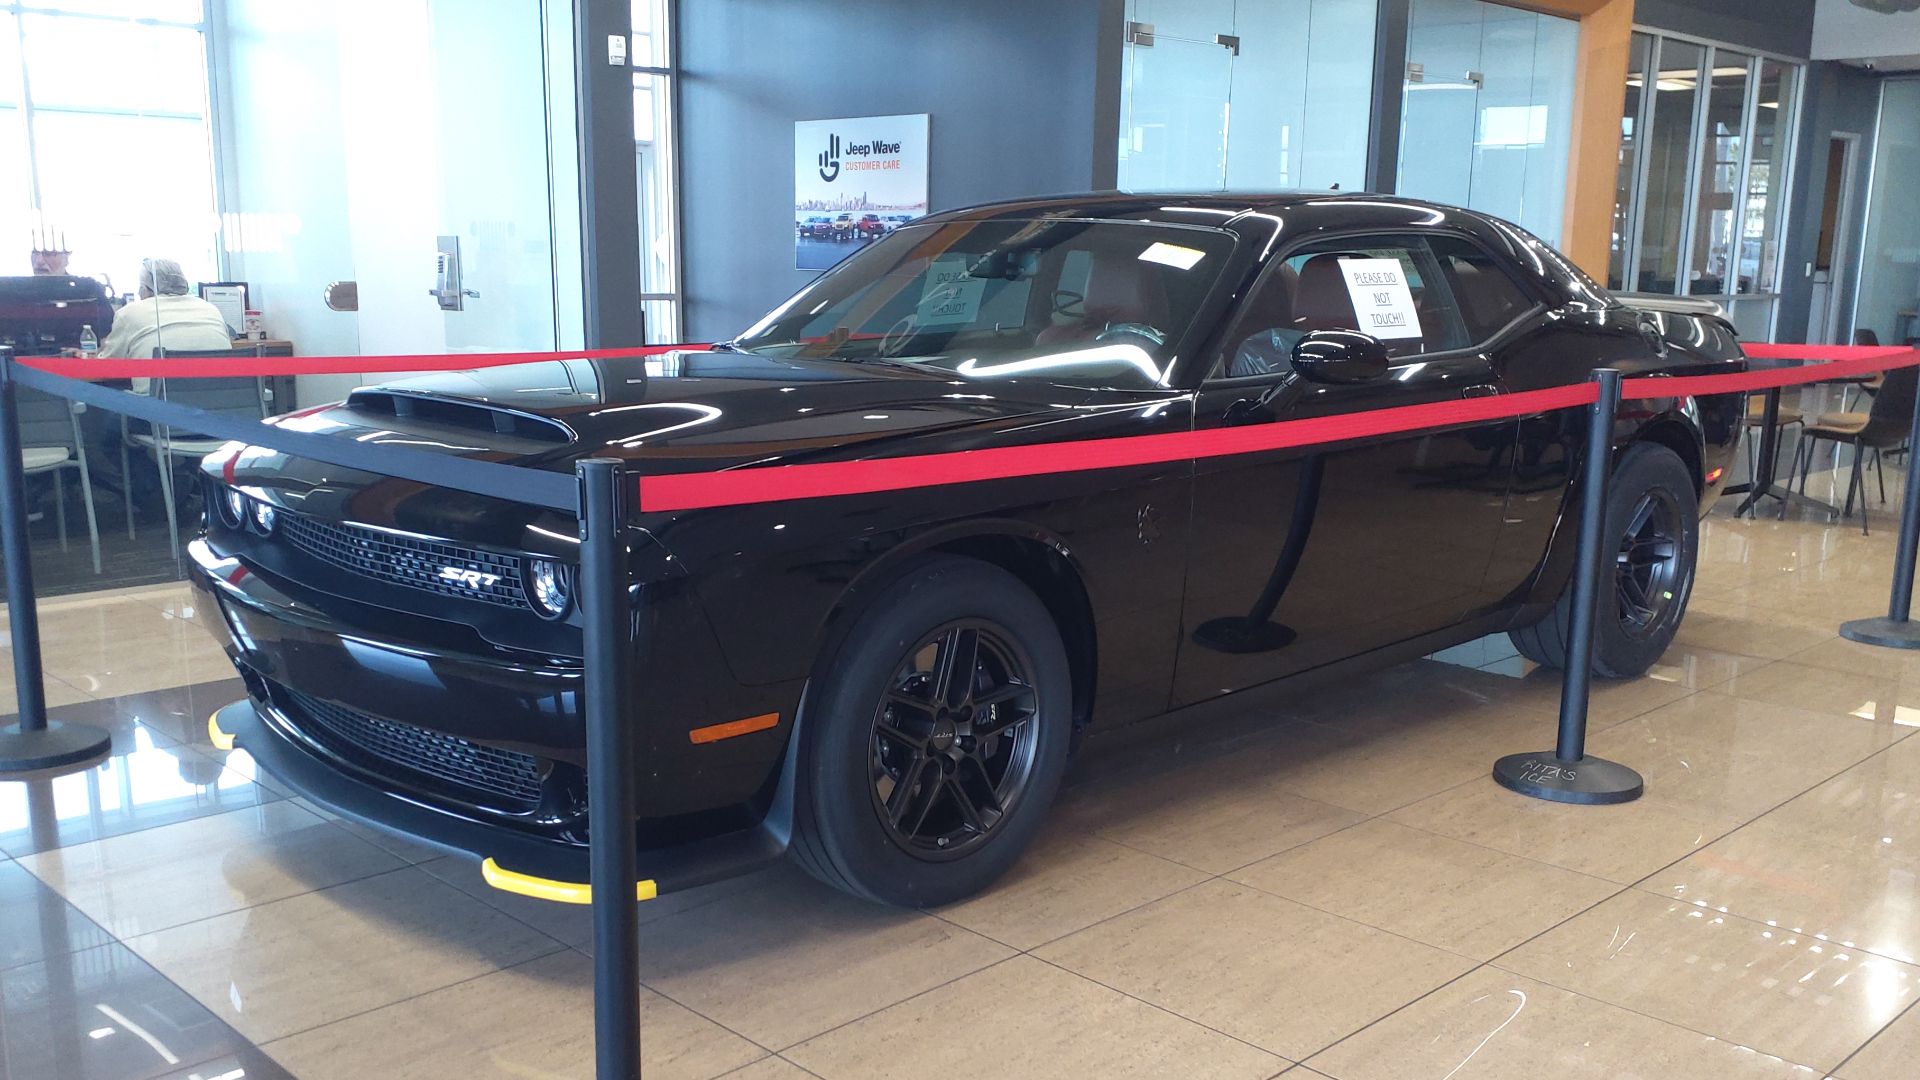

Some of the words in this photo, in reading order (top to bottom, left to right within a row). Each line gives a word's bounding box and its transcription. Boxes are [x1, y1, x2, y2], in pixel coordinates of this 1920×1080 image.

[845, 141, 870, 157] Jeep
[872, 140, 900, 155] Wave
[845, 161, 881, 171] CUSTOMER
[882, 159, 900, 170] CARE
[1354, 272, 1383, 283] PLEASE
[1383, 272, 1397, 283] DO
[1373, 292, 1392, 304] NOT
[1370, 312, 1406, 325] TOUCH!!
[438, 566, 503, 589] SRT
[1520, 760, 1577, 781] RITA'S
[1519, 771, 1552, 784] ICE
